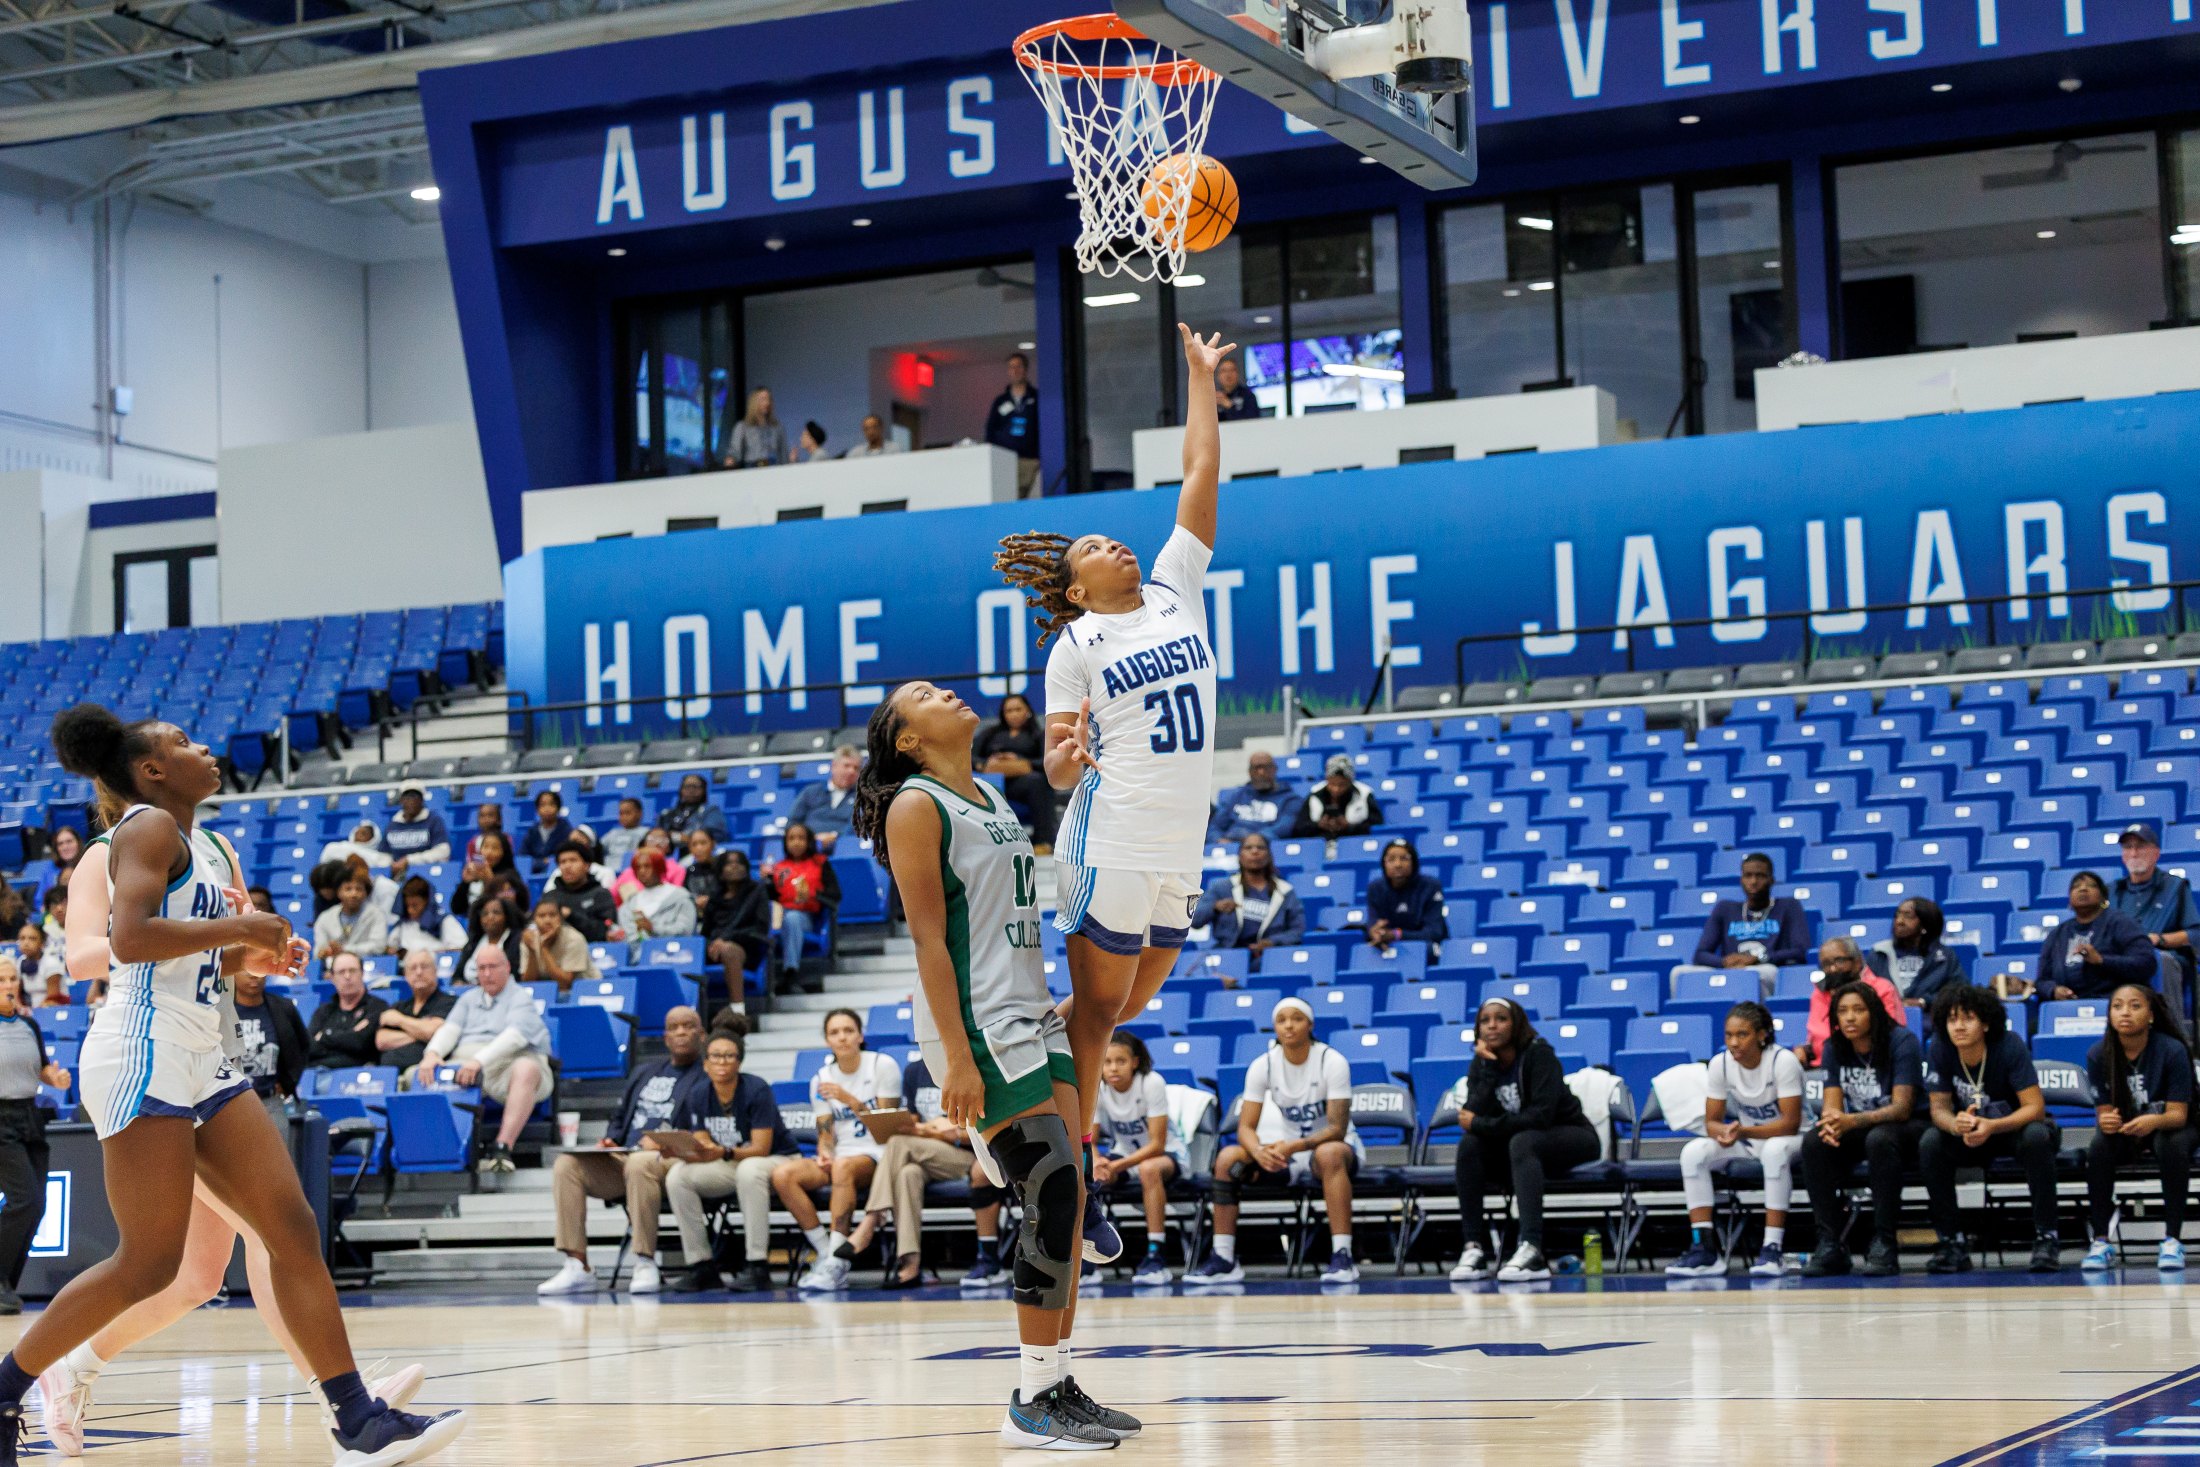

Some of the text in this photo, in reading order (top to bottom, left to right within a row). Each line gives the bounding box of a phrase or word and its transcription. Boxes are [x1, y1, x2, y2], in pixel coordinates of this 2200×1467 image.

[584, 490, 2172, 727] HOME O THE JAGUARS
[1102, 633, 1210, 699] AUGUSTA
[1143, 682, 1205, 754] 30
[1349, 1092, 1404, 1112] UGUSTA
